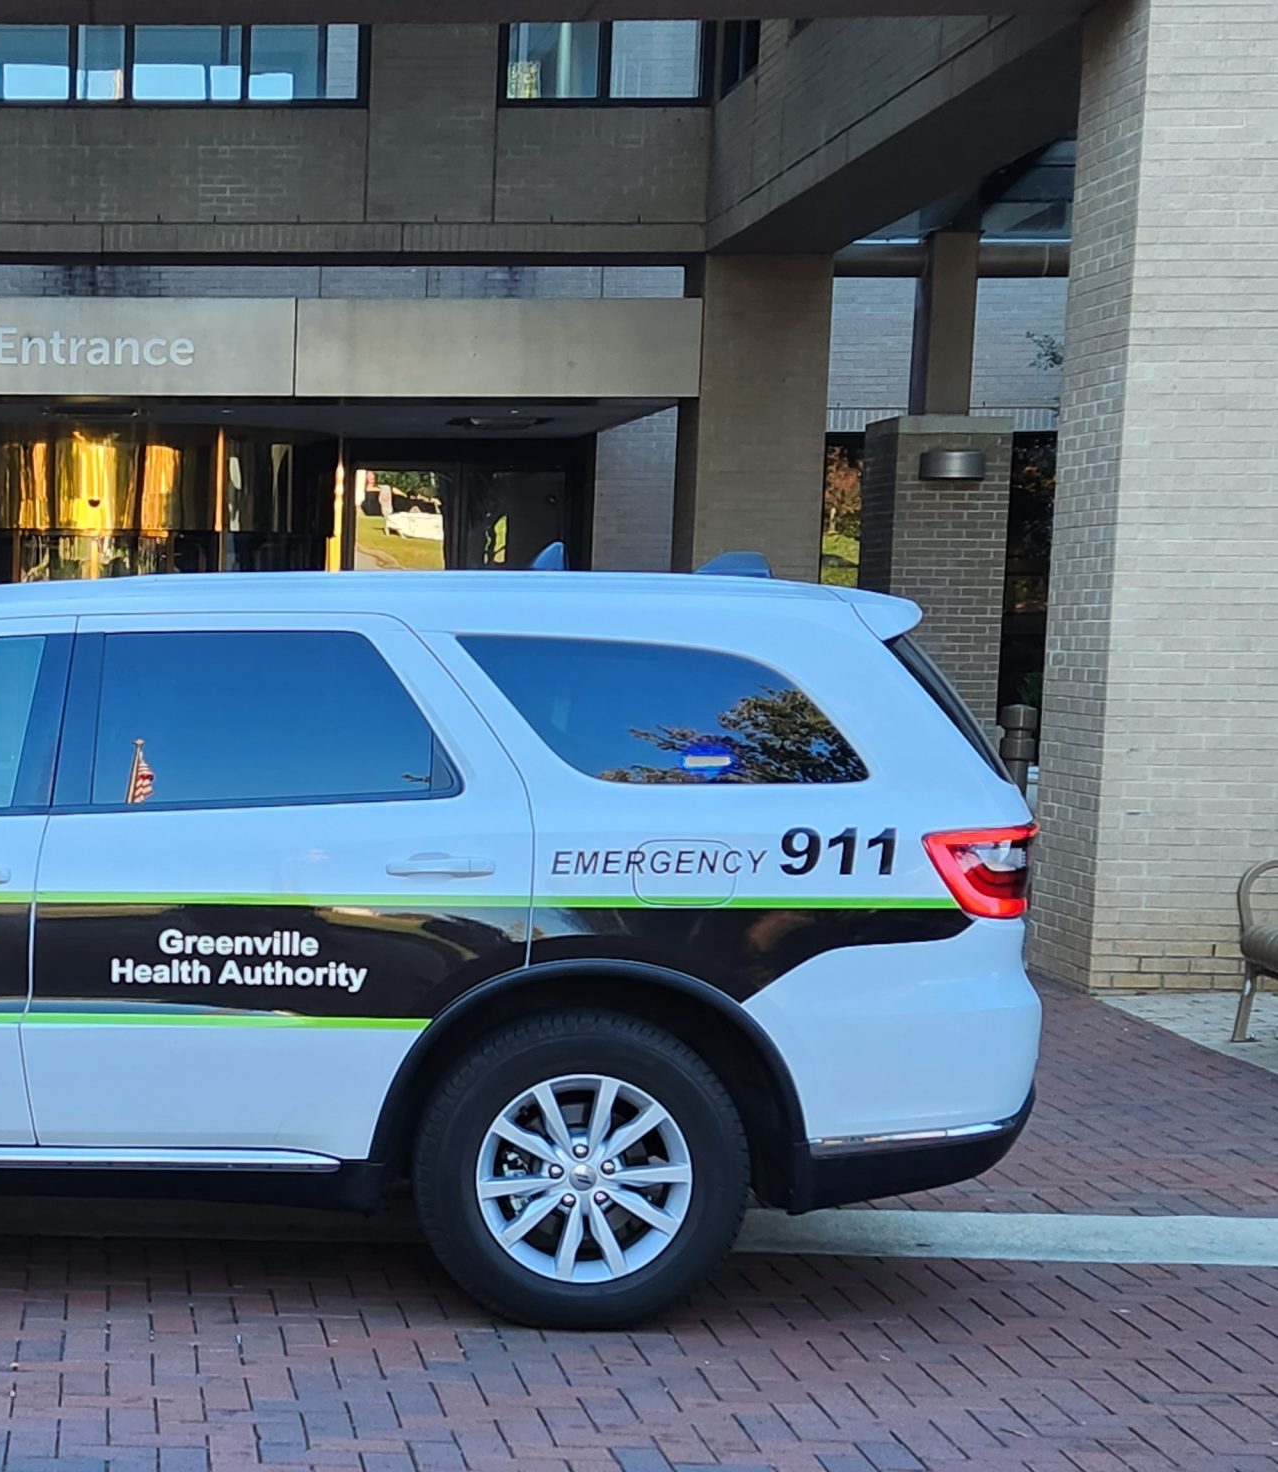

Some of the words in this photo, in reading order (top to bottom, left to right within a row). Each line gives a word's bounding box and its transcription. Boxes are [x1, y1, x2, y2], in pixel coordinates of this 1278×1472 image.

[551, 849, 768, 875] EMERGENCY
[779, 827, 898, 876] 911
[158, 928, 320, 957] Greenville
[111, 958, 212, 985] Health
[217, 959, 368, 993] Authority
